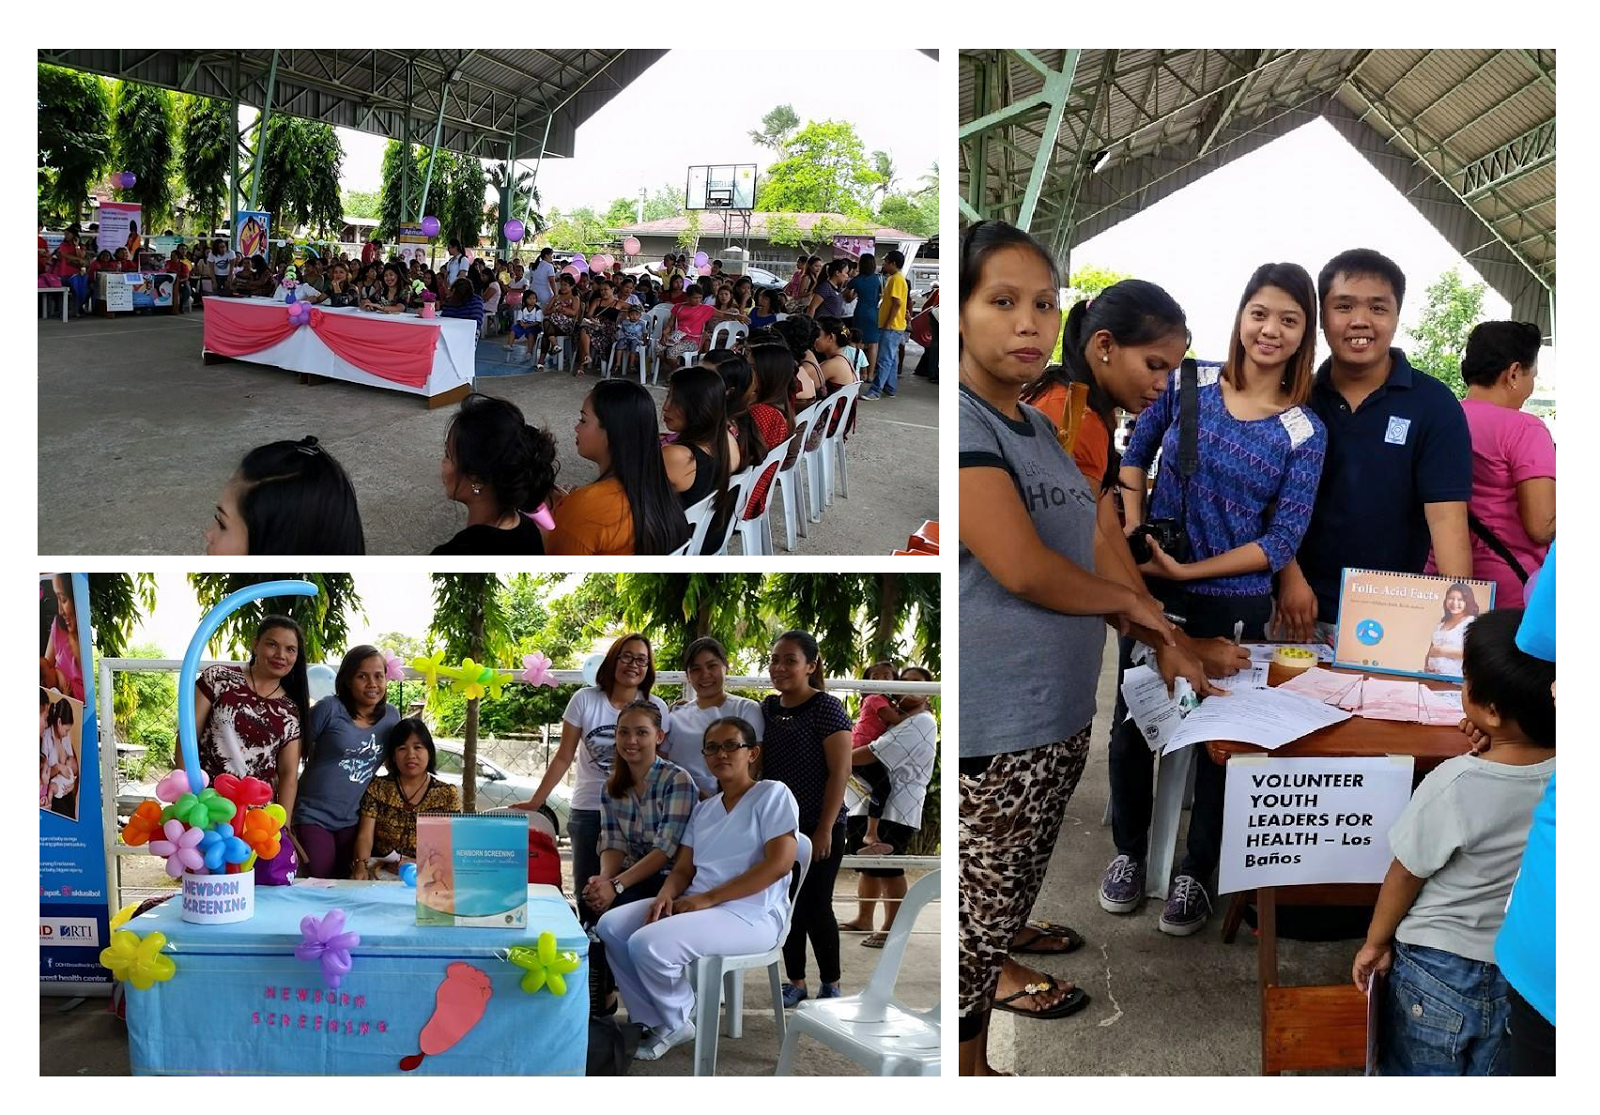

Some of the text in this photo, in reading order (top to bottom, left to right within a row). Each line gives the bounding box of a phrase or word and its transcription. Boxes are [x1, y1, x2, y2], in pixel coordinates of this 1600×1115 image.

[1351, 582, 1440, 601] Folic Acid Facts
[1251, 773, 1364, 789] VOLUNTEER
[1250, 794, 1318, 808] YOUTH
[1247, 813, 1374, 828] LEADERS FOR
[1246, 832, 1318, 848] HEALTH
[1341, 832, 1372, 846] Los
[456, 849, 515, 858] NEWBORN SCREENING
[1245, 852, 1302, 868] Baños
[184, 879, 240, 897] NEWBORN
[182, 896, 247, 915] SCREENING
[71, 925, 93, 938] RTI
[58, 974, 82, 982] health
[265, 986, 366, 1009] NEWBORN
[251, 1011, 389, 1036] SCREENING
